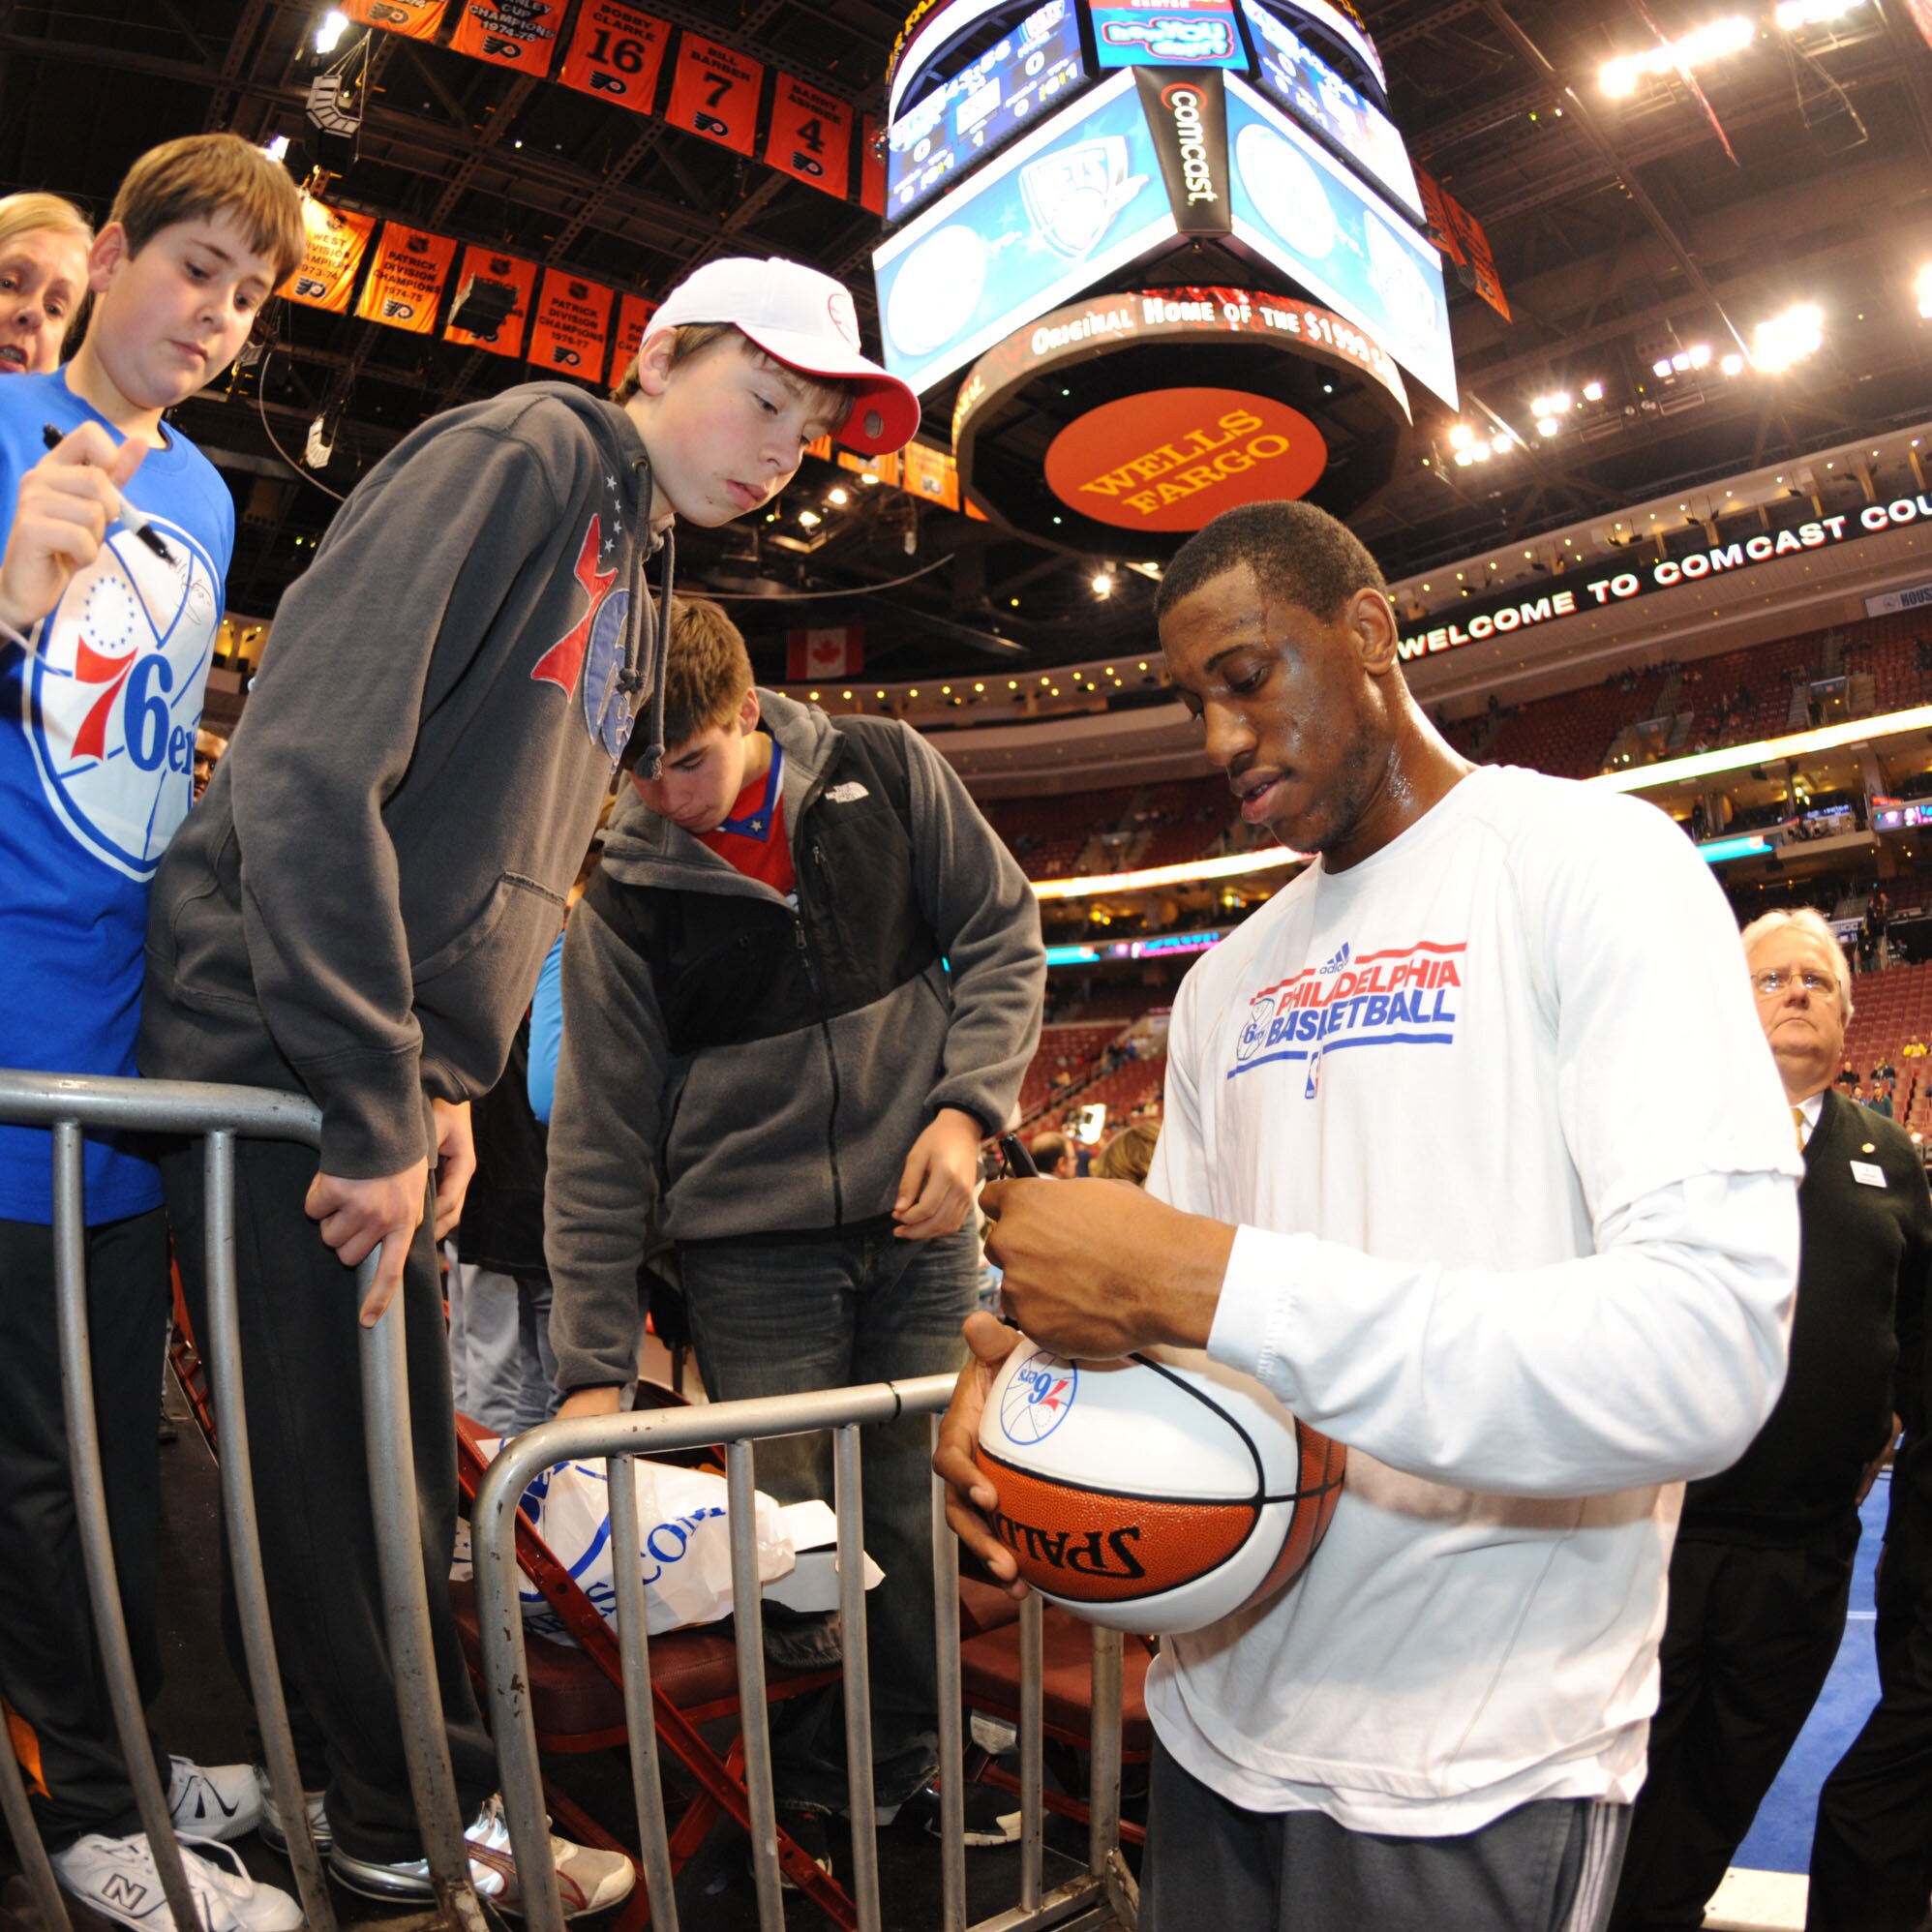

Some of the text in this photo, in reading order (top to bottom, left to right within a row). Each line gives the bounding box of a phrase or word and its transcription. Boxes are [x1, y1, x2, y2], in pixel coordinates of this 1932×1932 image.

[468, 4, 556, 39] CHAMPIONS
[500, 4, 532, 18] CUP
[599, 3, 655, 30] BOBBY
[482, 20, 537, 43] 1974-75
[591, 12, 656, 43] CLARKE
[585, 27, 647, 75] 16
[706, 47, 739, 67] BILL
[689, 50, 752, 82] BARBER
[702, 71, 734, 108] 7
[791, 83, 838, 113] BARRY
[796, 117, 827, 154] 4
[306, 242, 351, 259] IVISION
[313, 232, 347, 247] WEST
[301, 264, 339, 281] 973-74
[383, 261, 438, 283] DIVISION
[388, 251, 438, 272] PATRICK
[373, 269, 441, 296] CHAMPIONS
[548, 308, 598, 329] DIVISION
[551, 297, 598, 318] PATRICK
[538, 317, 605, 344] CHAMPIONS
[1078, 408, 1263, 497] WELLS
[1121, 435, 1289, 515] FARGO
[1398, 590, 1577, 661] WELCOME
[1586, 573, 1640, 604] TO
[1652, 516, 1846, 587] COMCAST
[1275, 958, 1462, 1017] PHILADELPHIA
[1264, 988, 1456, 1048] BASKETBALL
